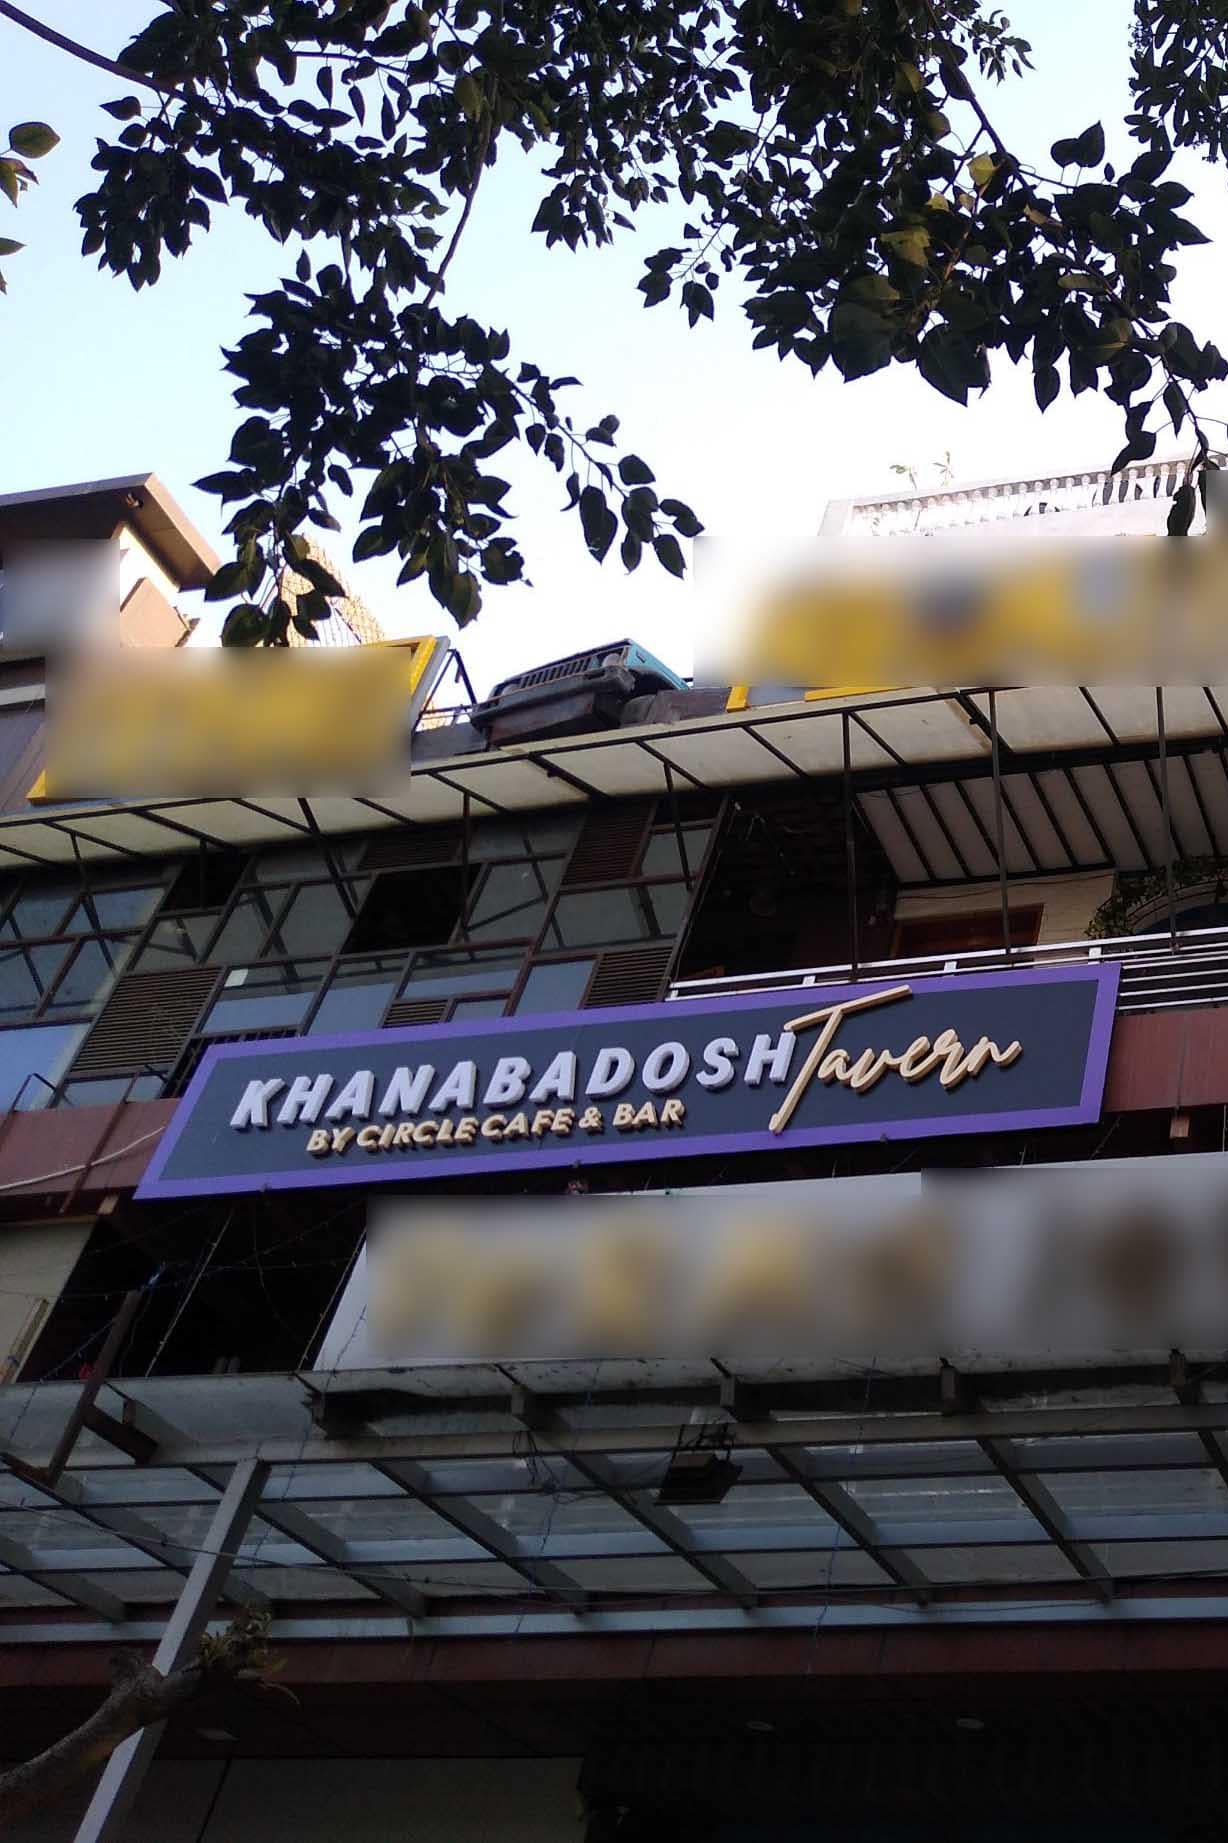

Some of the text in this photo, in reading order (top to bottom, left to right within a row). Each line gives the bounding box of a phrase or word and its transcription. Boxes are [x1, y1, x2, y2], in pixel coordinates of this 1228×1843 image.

[230, 984, 1023, 1134] KHANABADOSH Tavern
[306, 1098, 686, 1154] BY CIRCLE CAFE & BAR
